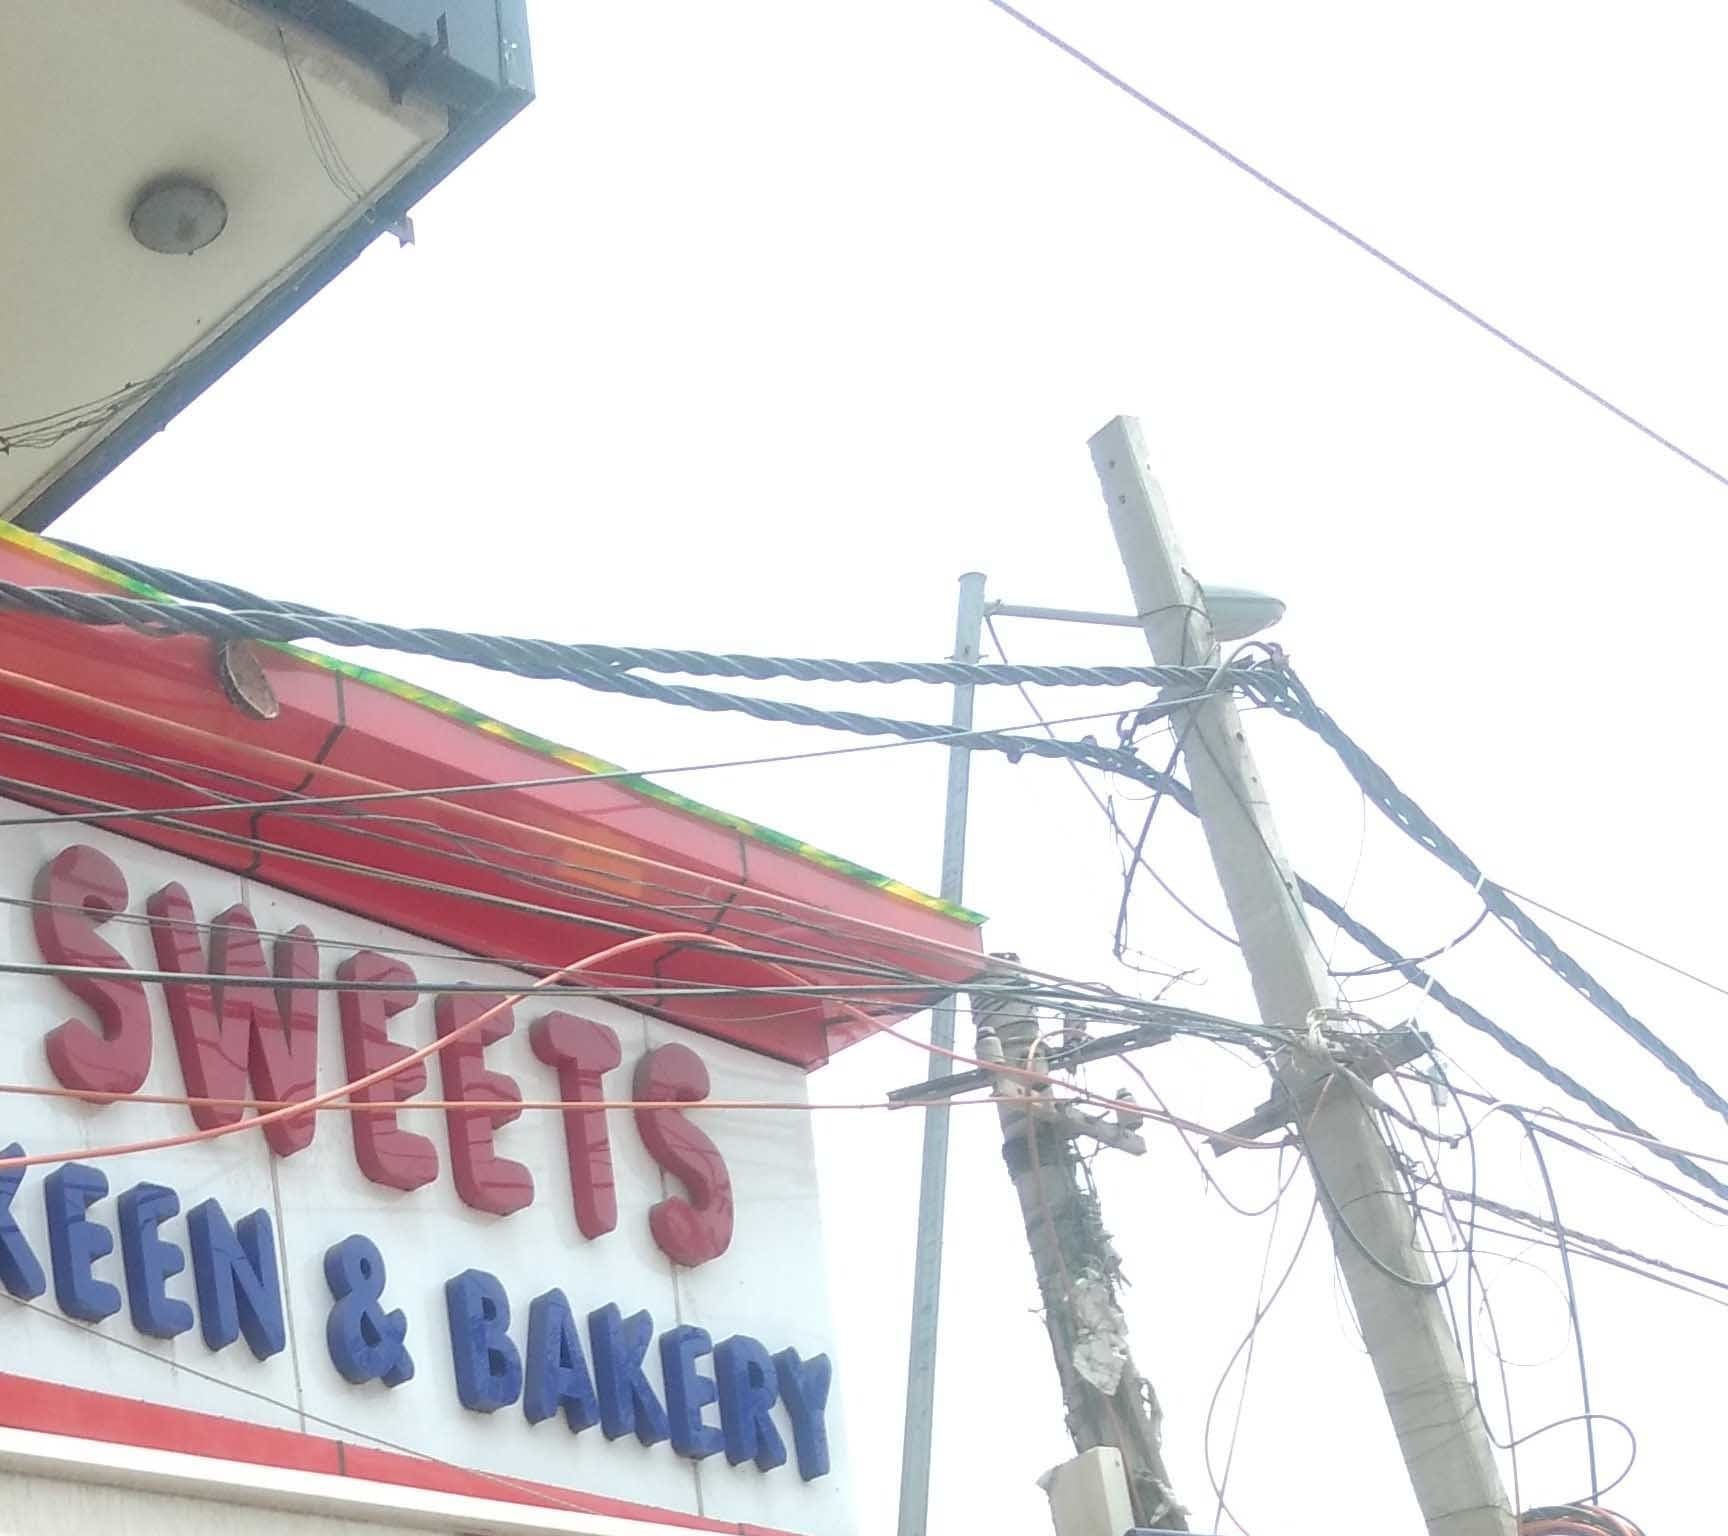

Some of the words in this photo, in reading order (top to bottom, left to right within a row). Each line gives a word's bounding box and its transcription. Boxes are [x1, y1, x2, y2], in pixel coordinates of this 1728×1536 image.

[30, 844, 734, 1270] SWEETS
[325, 1233, 415, 1388] &
[445, 1268, 834, 1482] BAKERY
